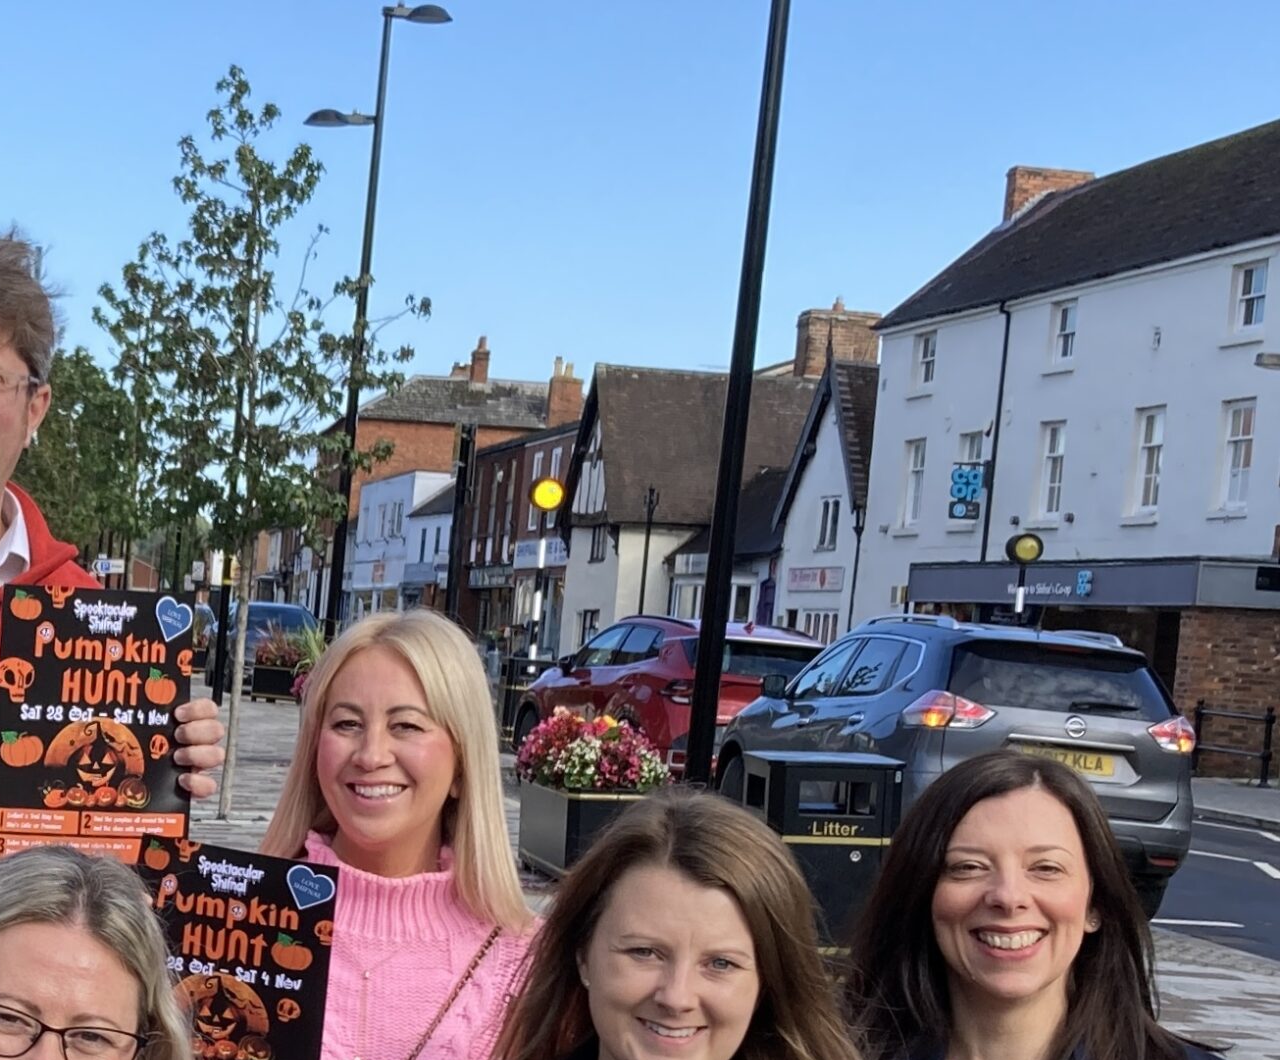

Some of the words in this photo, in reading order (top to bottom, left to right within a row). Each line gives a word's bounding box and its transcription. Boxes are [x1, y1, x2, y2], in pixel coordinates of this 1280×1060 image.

[73, 598, 138, 622] Spooktacular
[88, 616, 123, 637] Shifnal
[34, 621, 167, 670] Pumpkin
[46, 707, 64, 721] 28
[137, 710, 144, 725] 4
[1073, 753, 1104, 771] KLA
[83, 814, 91, 830] 2
[813, 821, 857, 837] Litter
[197, 855, 265, 884] Spooktacular
[211, 874, 247, 896] Shifnal
[157, 873, 300, 931] Pumpkin
[261, 970, 270, 986] 4
